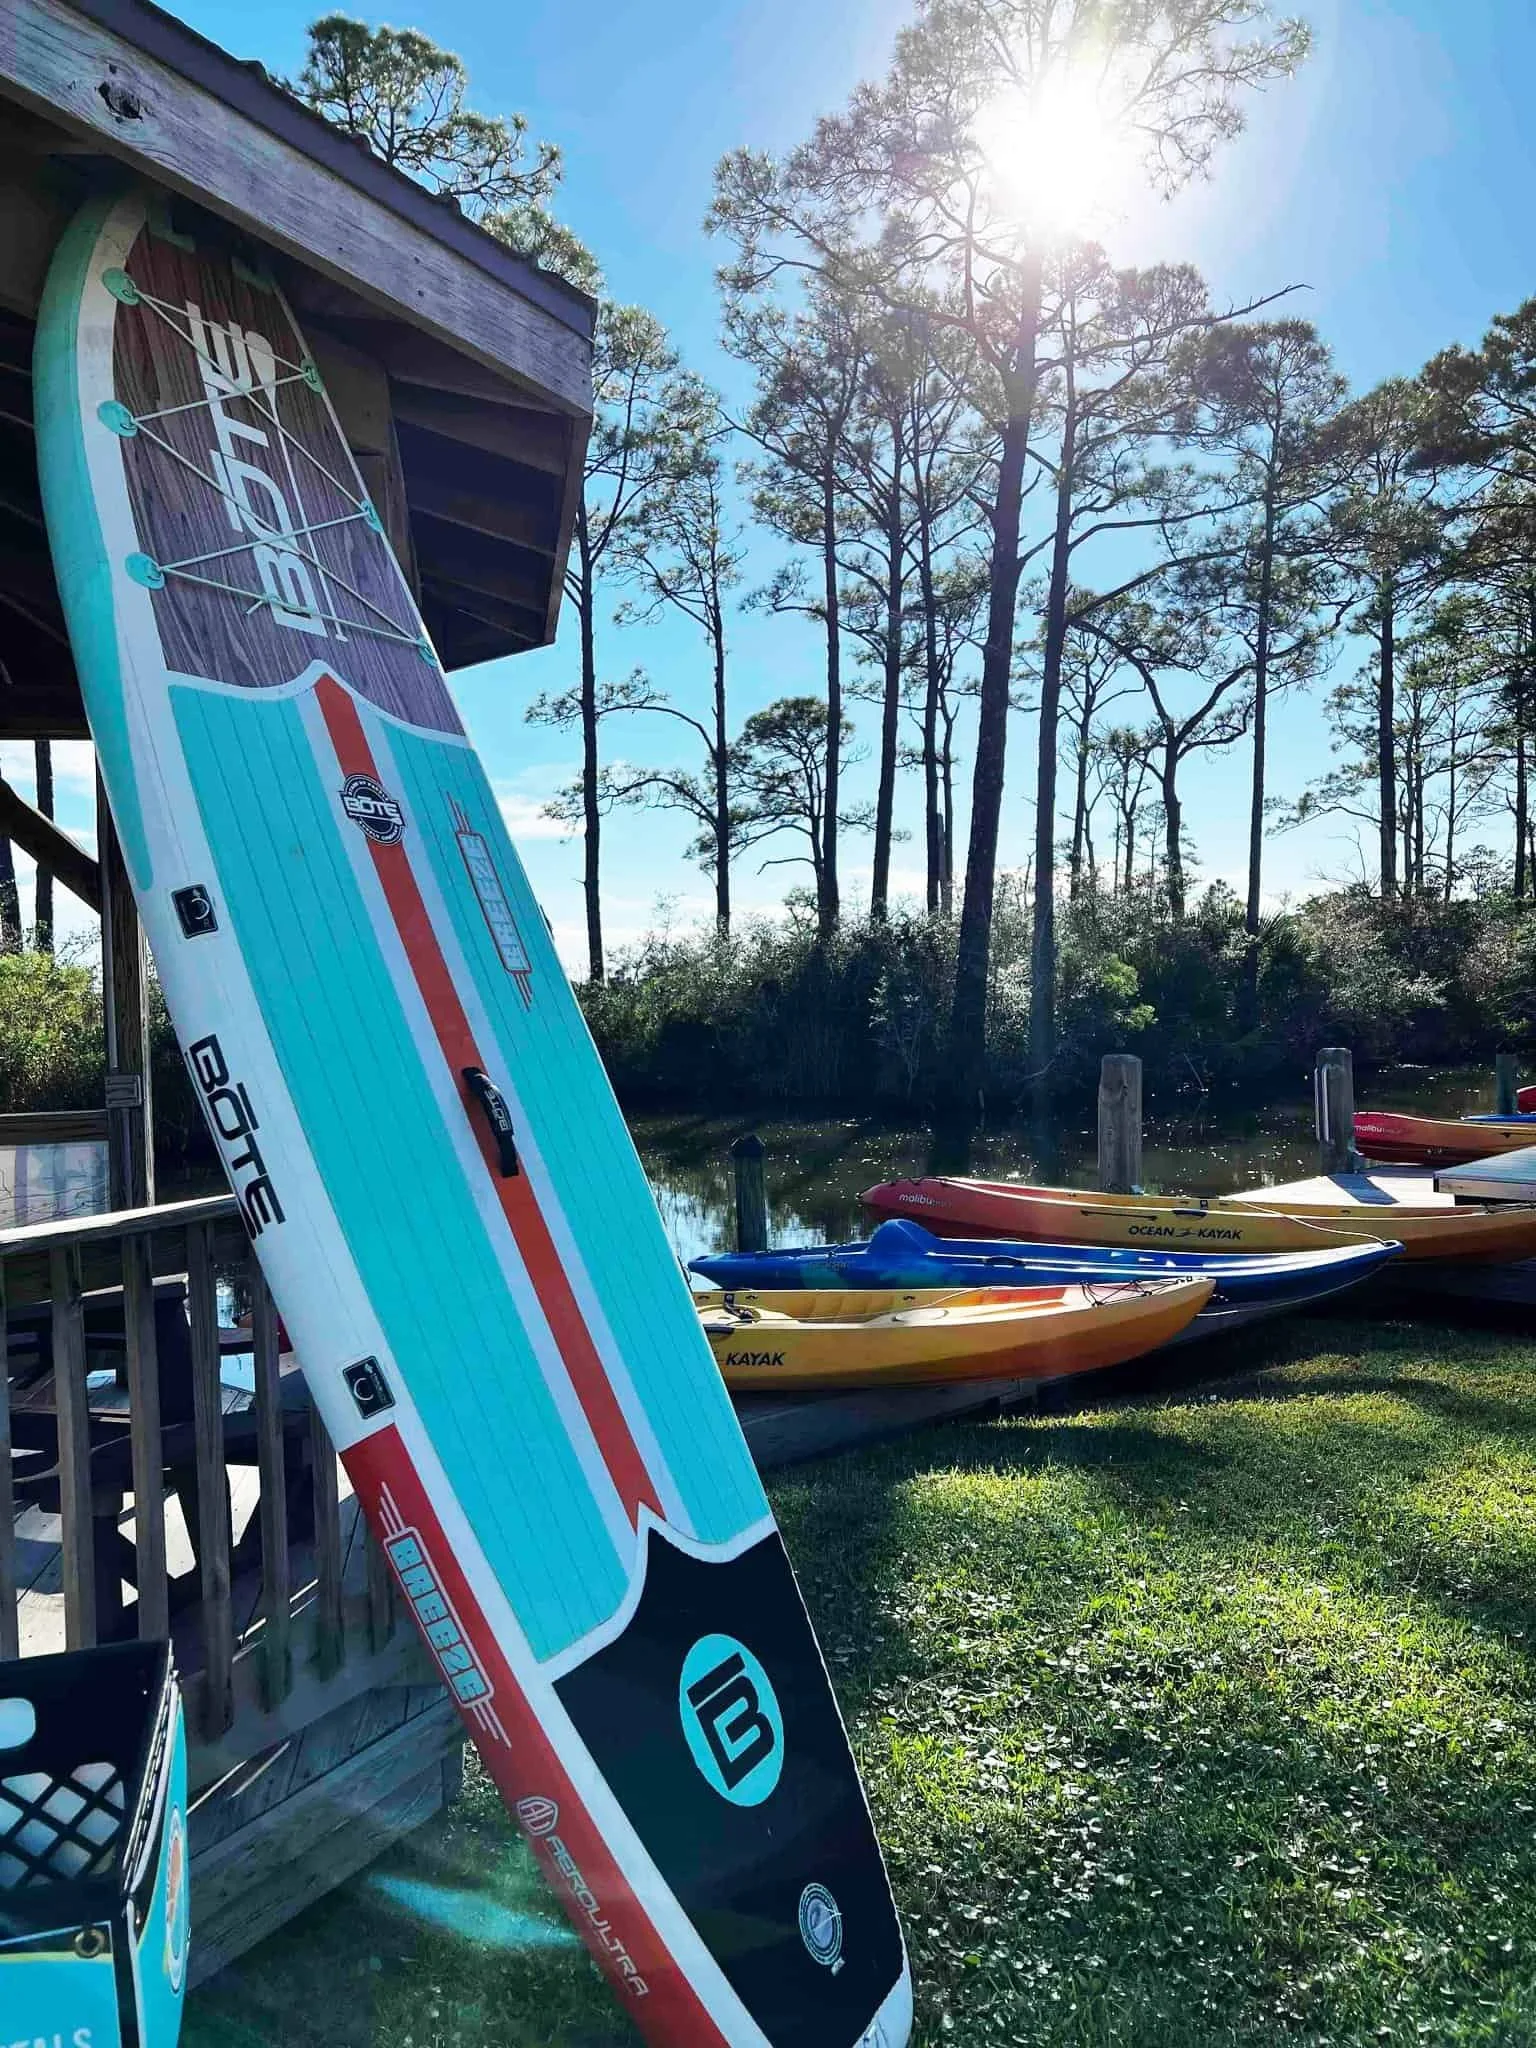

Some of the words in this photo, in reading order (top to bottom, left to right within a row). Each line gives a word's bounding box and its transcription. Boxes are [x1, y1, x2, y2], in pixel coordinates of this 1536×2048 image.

[898, 1192, 933, 1206] malibu
[1128, 1225, 1175, 1238] OCEAN
[1197, 1229, 1244, 1241] KAYAK
[725, 1352, 787, 1366] KAYAK
[388, 1536, 489, 1702] BREEZE
[546, 1836, 649, 1996] AEROULTRA
